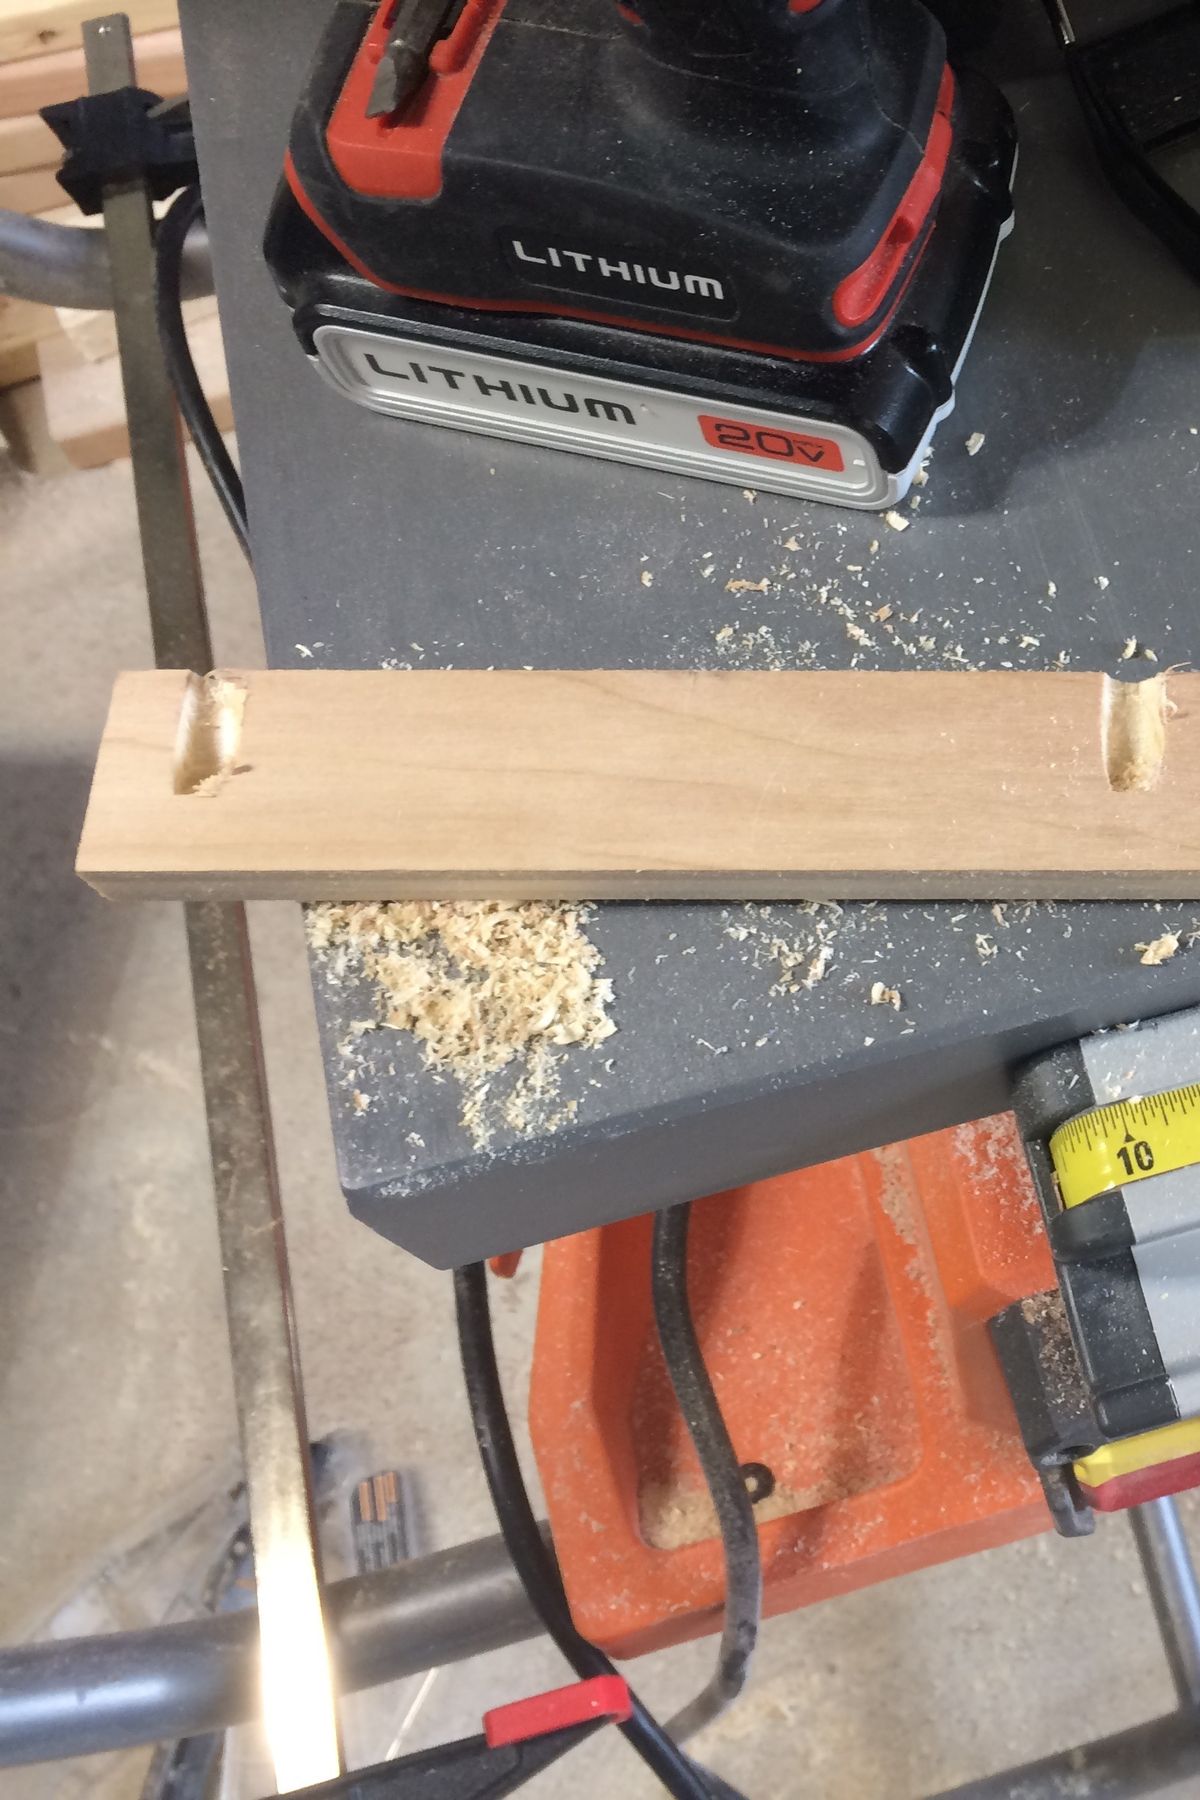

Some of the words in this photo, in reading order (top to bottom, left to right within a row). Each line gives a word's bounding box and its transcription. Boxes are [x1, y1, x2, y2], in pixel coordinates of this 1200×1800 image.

[511, 240, 724, 300] LITHIUM
[363, 352, 637, 425] LITHIUM
[1116, 1140, 1154, 1175] 10
